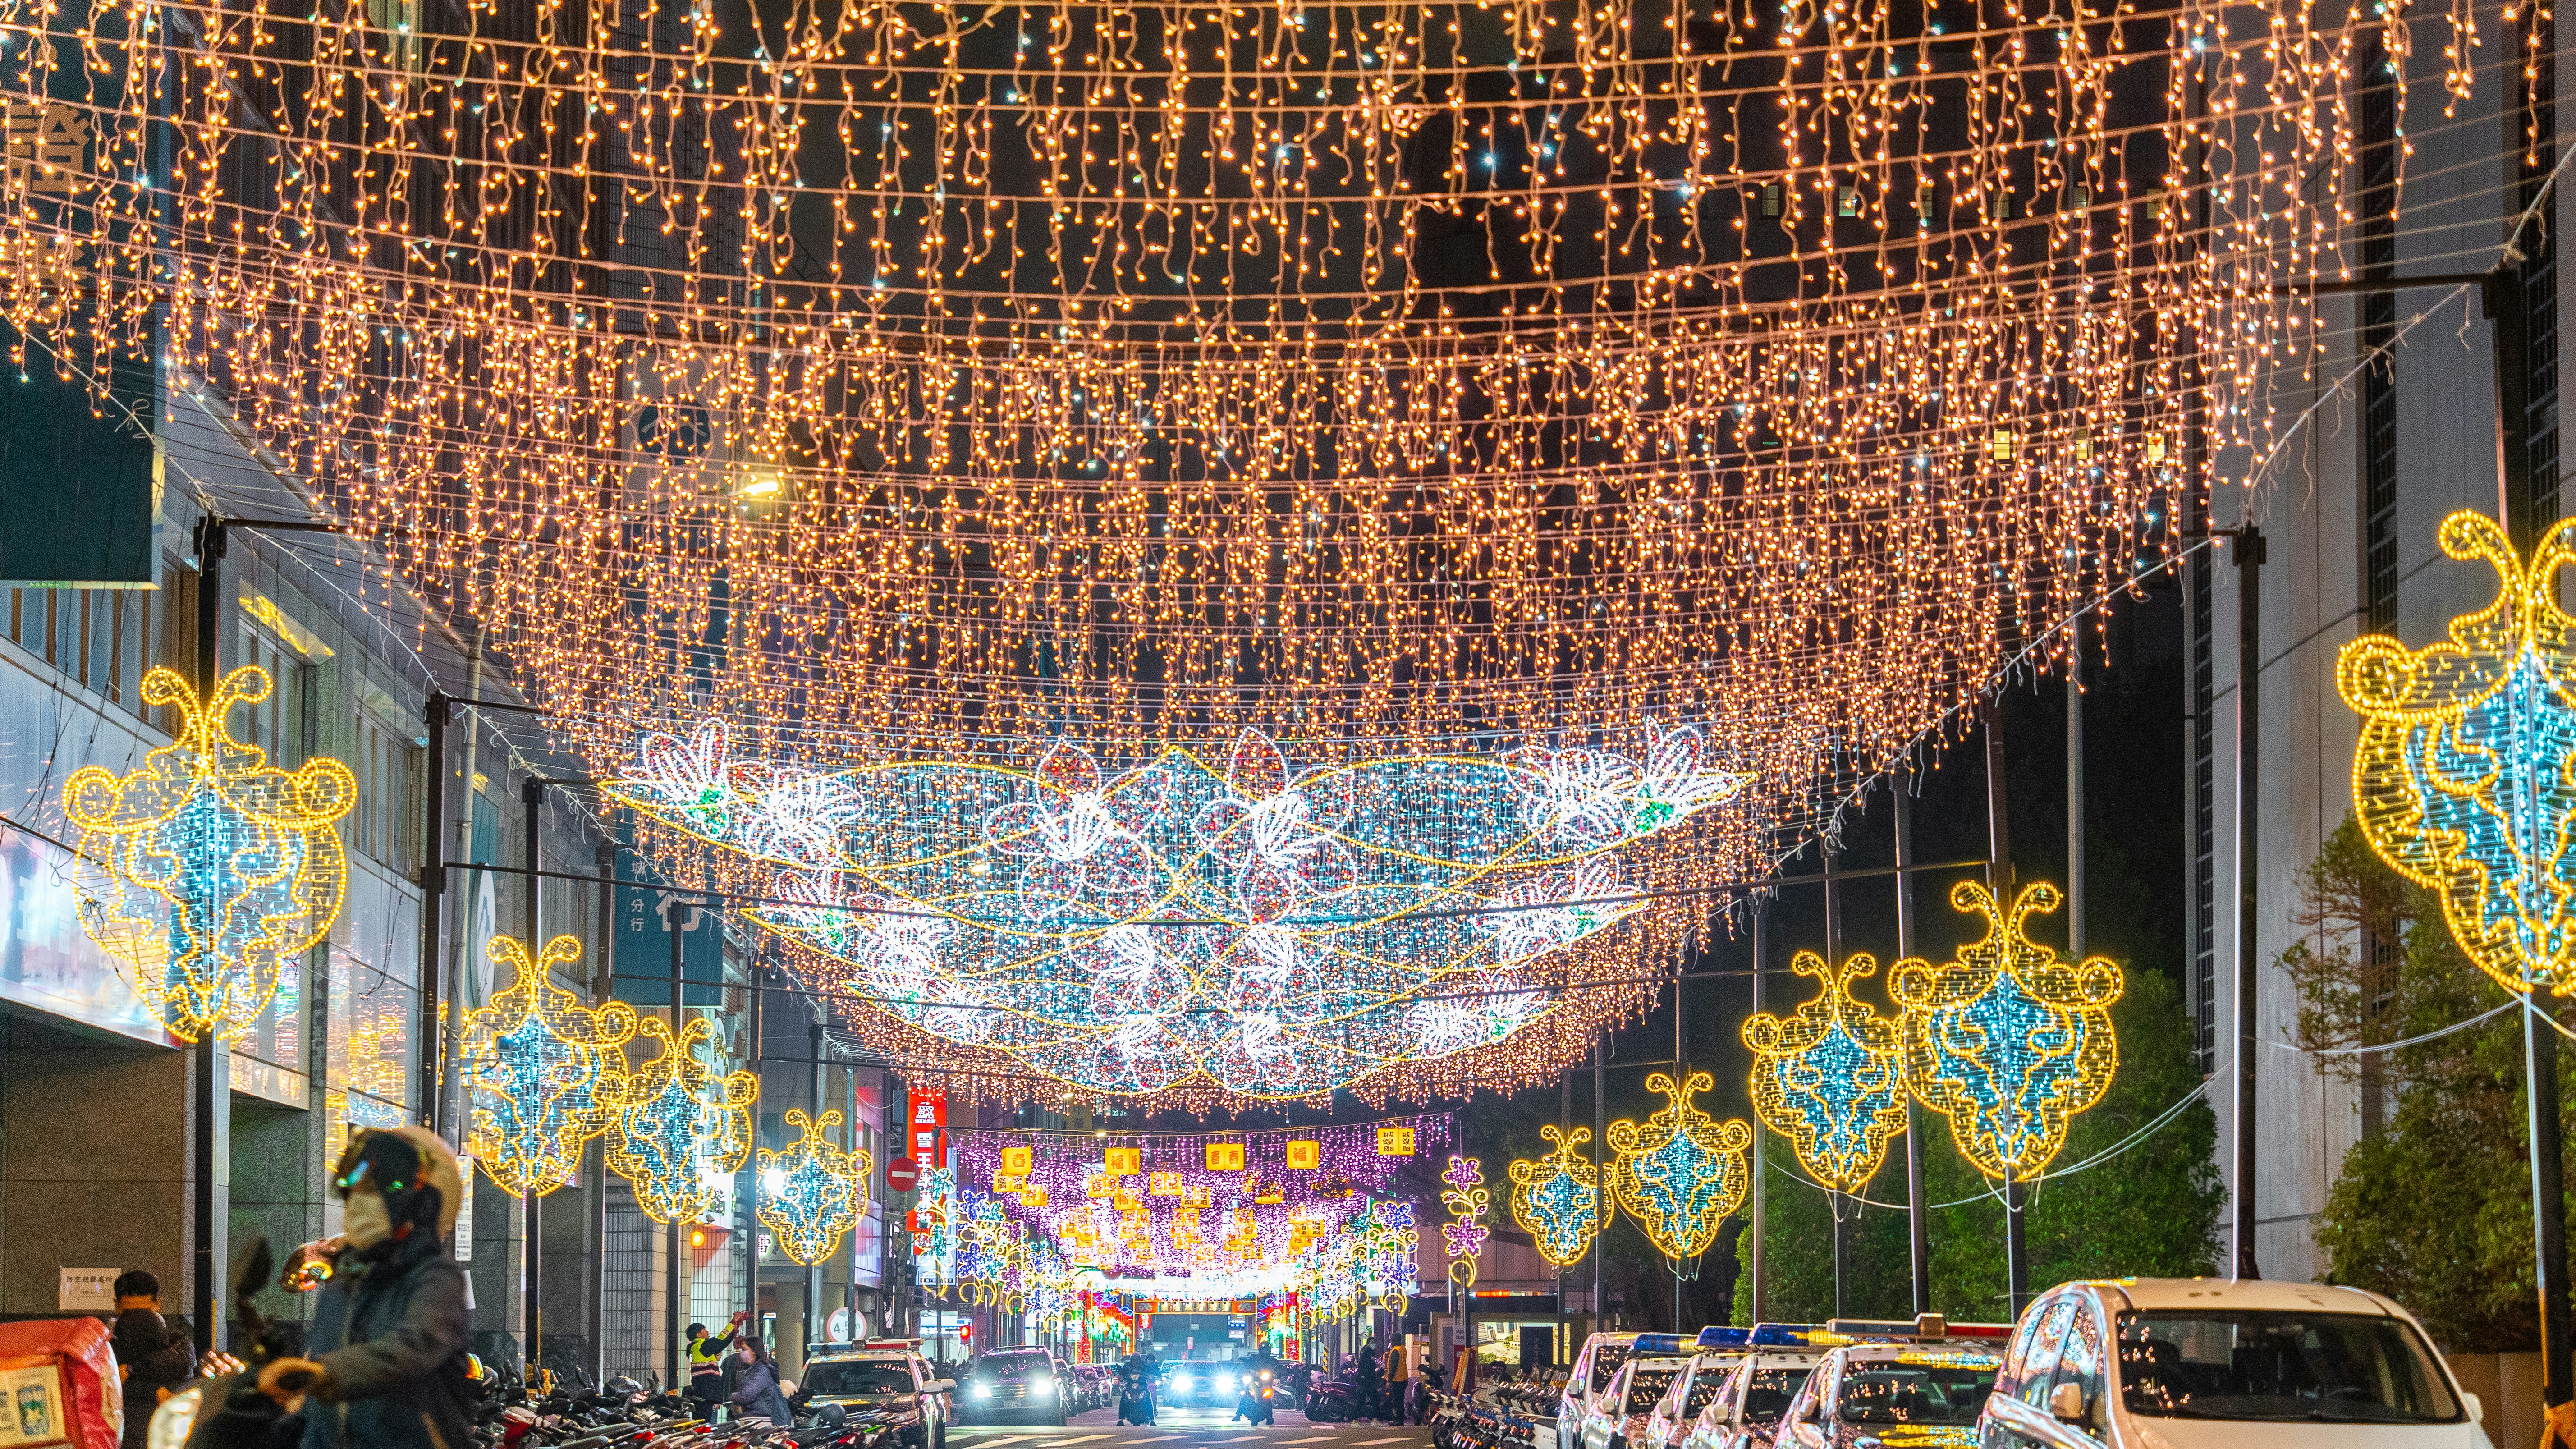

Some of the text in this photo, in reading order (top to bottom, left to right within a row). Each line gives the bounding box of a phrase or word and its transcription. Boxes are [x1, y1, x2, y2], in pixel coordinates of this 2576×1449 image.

[1383, 1131, 1394, 1152] 城隍廟
[1402, 1131, 1411, 1151] 城隍廟
[1012, 1153, 1026, 1167] 春
[1111, 1155, 1124, 1169] 福
[1132, 1155, 1137, 1169] 福
[1210, 1150, 1220, 1165] 春
[1228, 1150, 1239, 1165] 春
[1293, 1147, 1307, 1162] 福
[1025, 1189, 1036, 1201] 春
